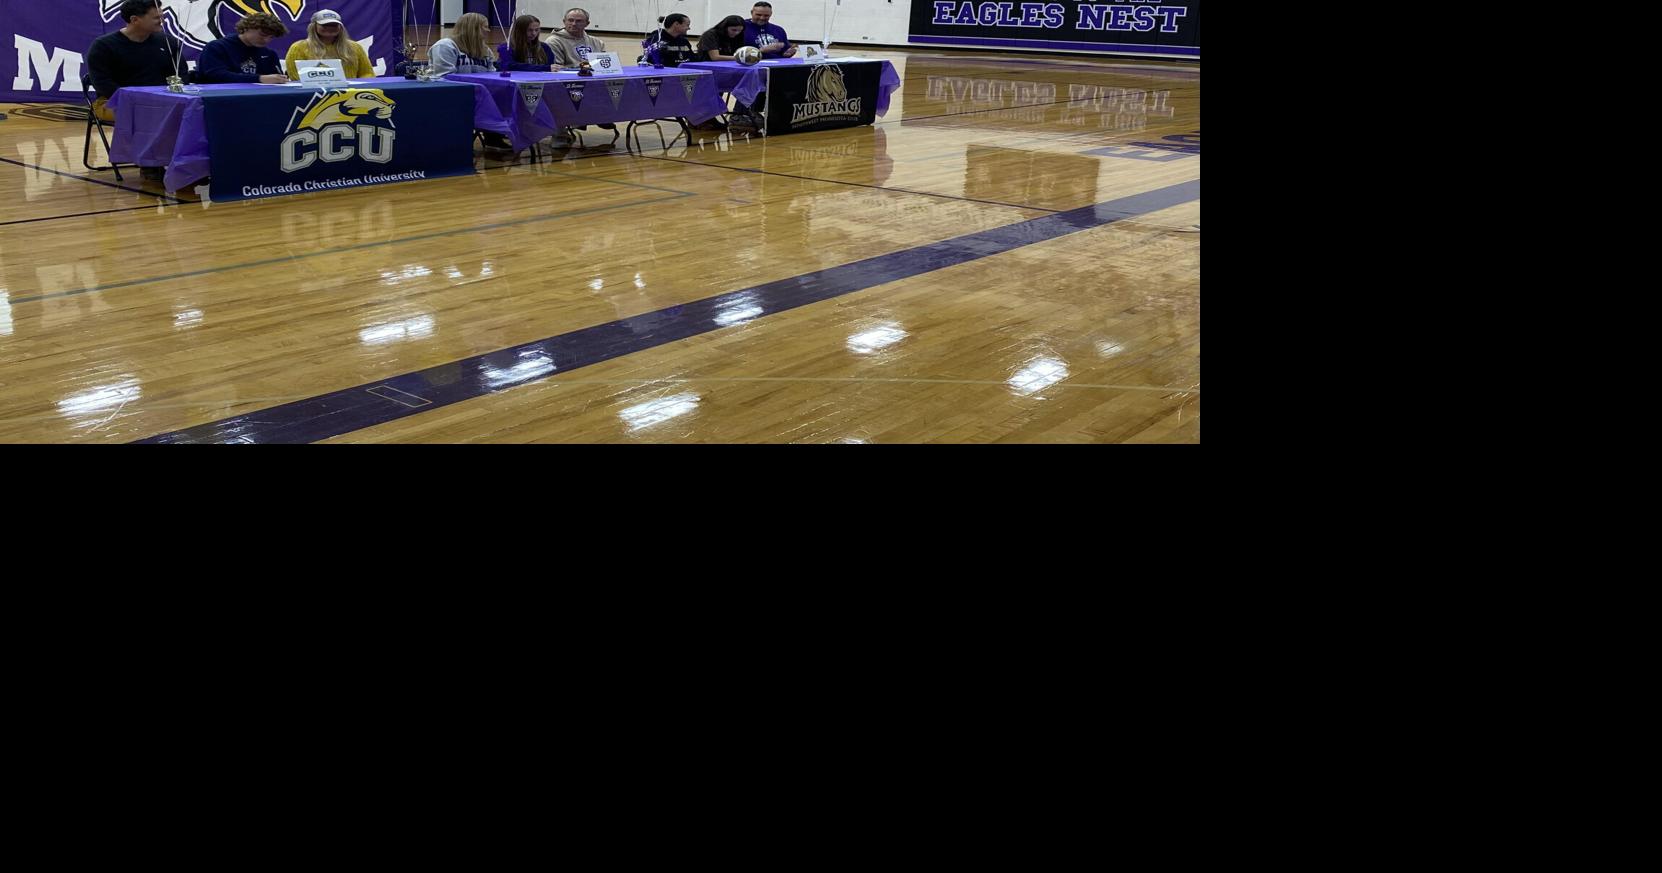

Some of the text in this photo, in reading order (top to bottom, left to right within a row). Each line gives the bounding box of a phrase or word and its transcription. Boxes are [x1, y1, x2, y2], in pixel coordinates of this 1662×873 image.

[932, 1, 1187, 33] EAGLES NEST
[790, 97, 862, 124] MUSTANGS
[280, 123, 396, 173] CCU
[242, 170, 426, 197] Colorado Christian University
